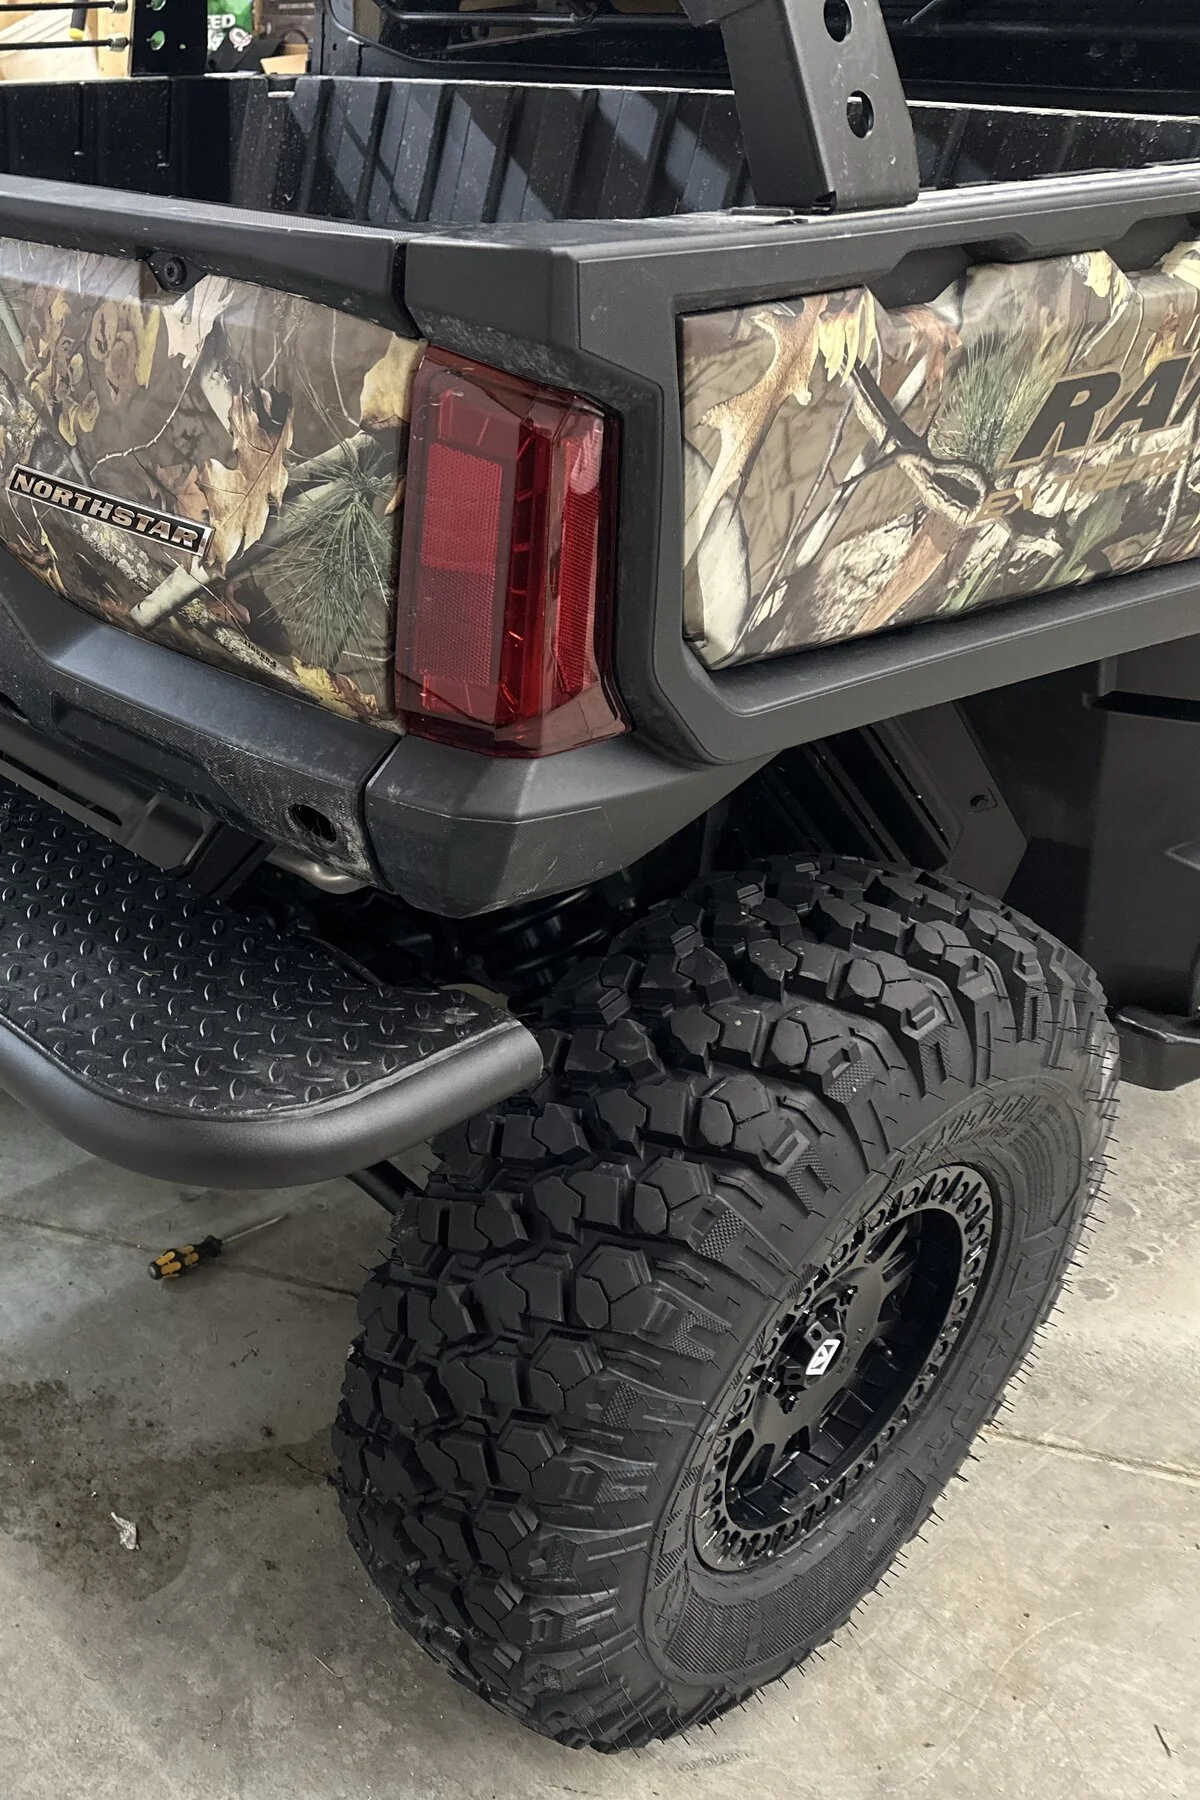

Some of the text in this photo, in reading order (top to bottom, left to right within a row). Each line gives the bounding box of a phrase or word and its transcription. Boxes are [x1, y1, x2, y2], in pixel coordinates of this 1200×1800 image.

[207, 14, 236, 29] ED
[1003, 354, 1200, 467] RA
[14, 473, 199, 548] NORTHSTAR
